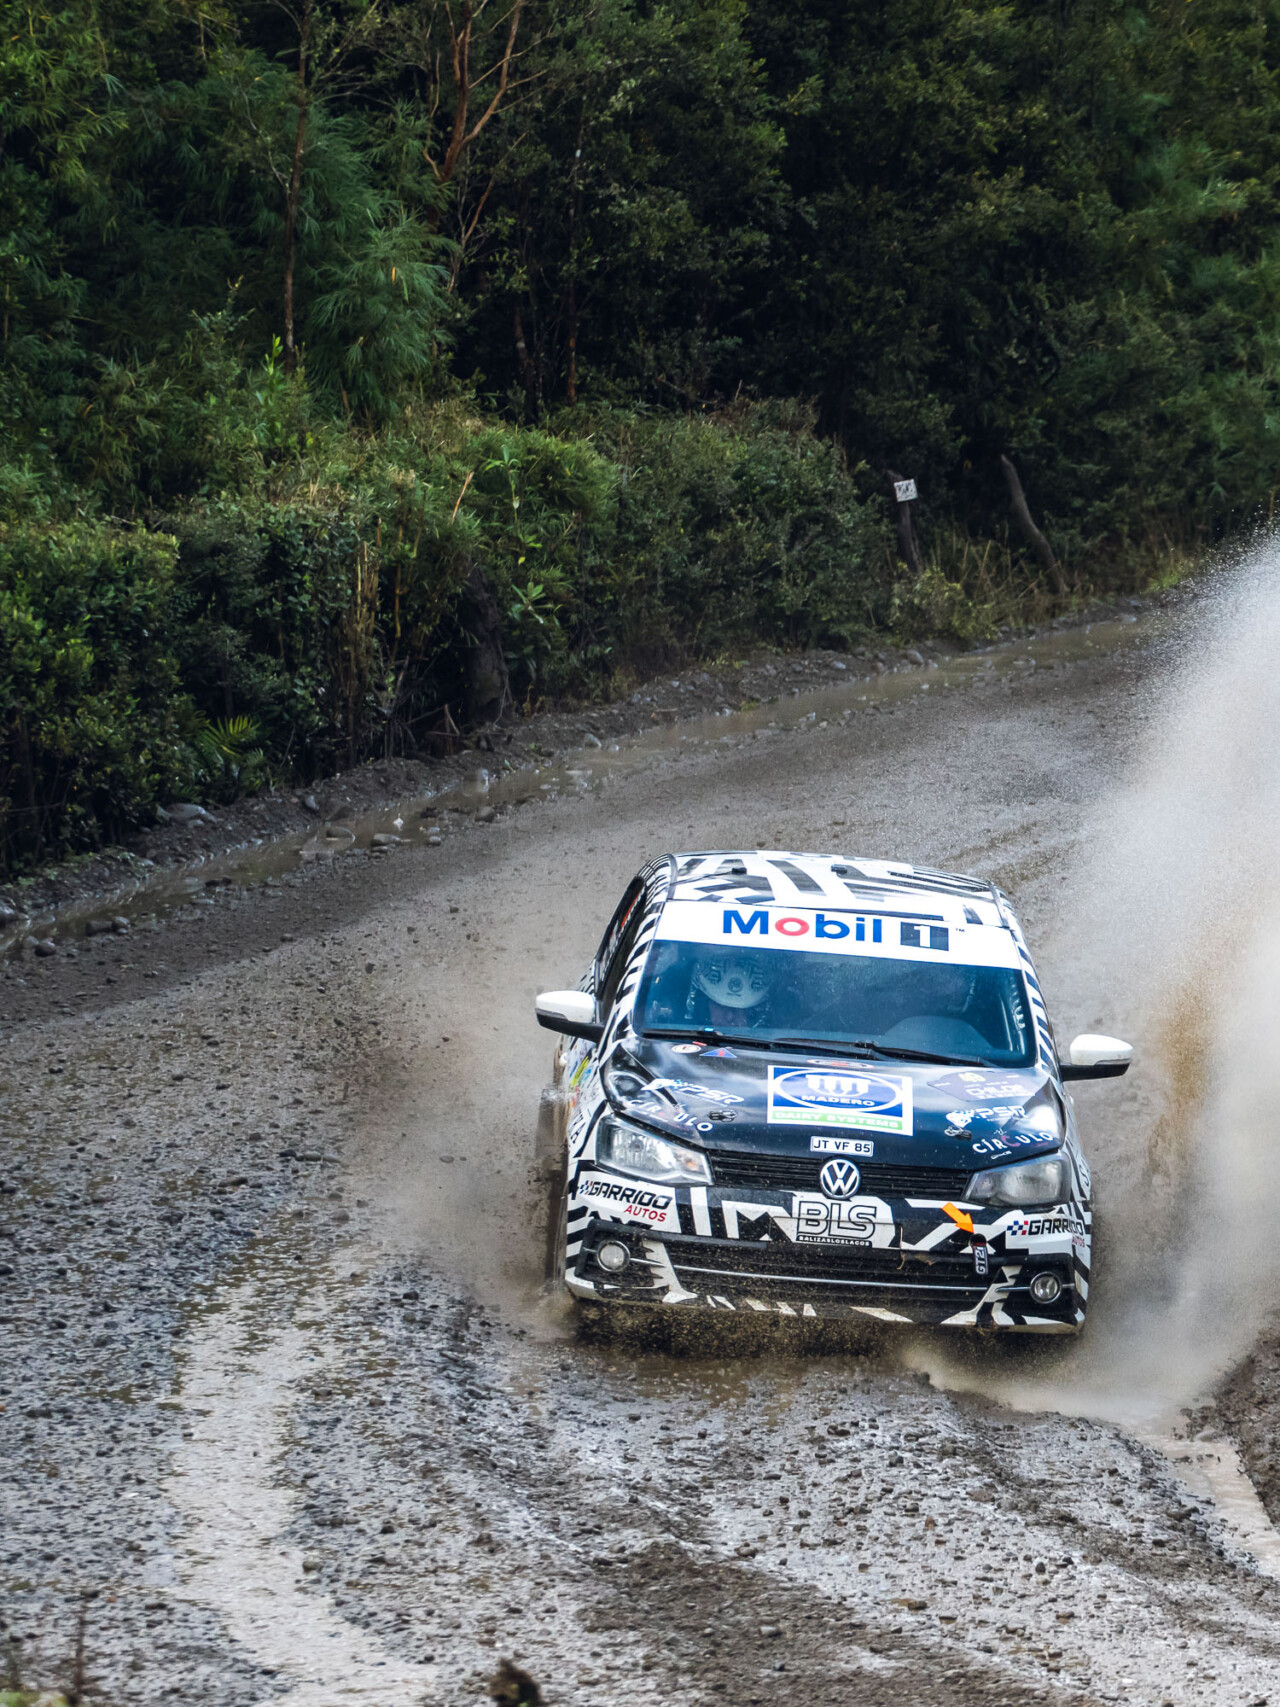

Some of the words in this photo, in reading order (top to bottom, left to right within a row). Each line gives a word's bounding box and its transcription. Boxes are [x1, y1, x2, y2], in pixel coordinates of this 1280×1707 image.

[723, 910, 882, 943] Mobil
[801, 1095, 876, 1107] MADERO
[775, 1112, 824, 1121] DAIRY
[826, 1115, 899, 1129] SYSTEMS
[976, 1105, 1026, 1119] PSR
[813, 1139, 829, 1149] JT
[834, 1141, 850, 1150] VF
[854, 1143, 871, 1153] 85
[589, 1181, 673, 1210] GARRIDO
[624, 1205, 667, 1222] AUTOS
[796, 1201, 877, 1240] BLS
[1028, 1218, 1084, 1236] GARRIDO
